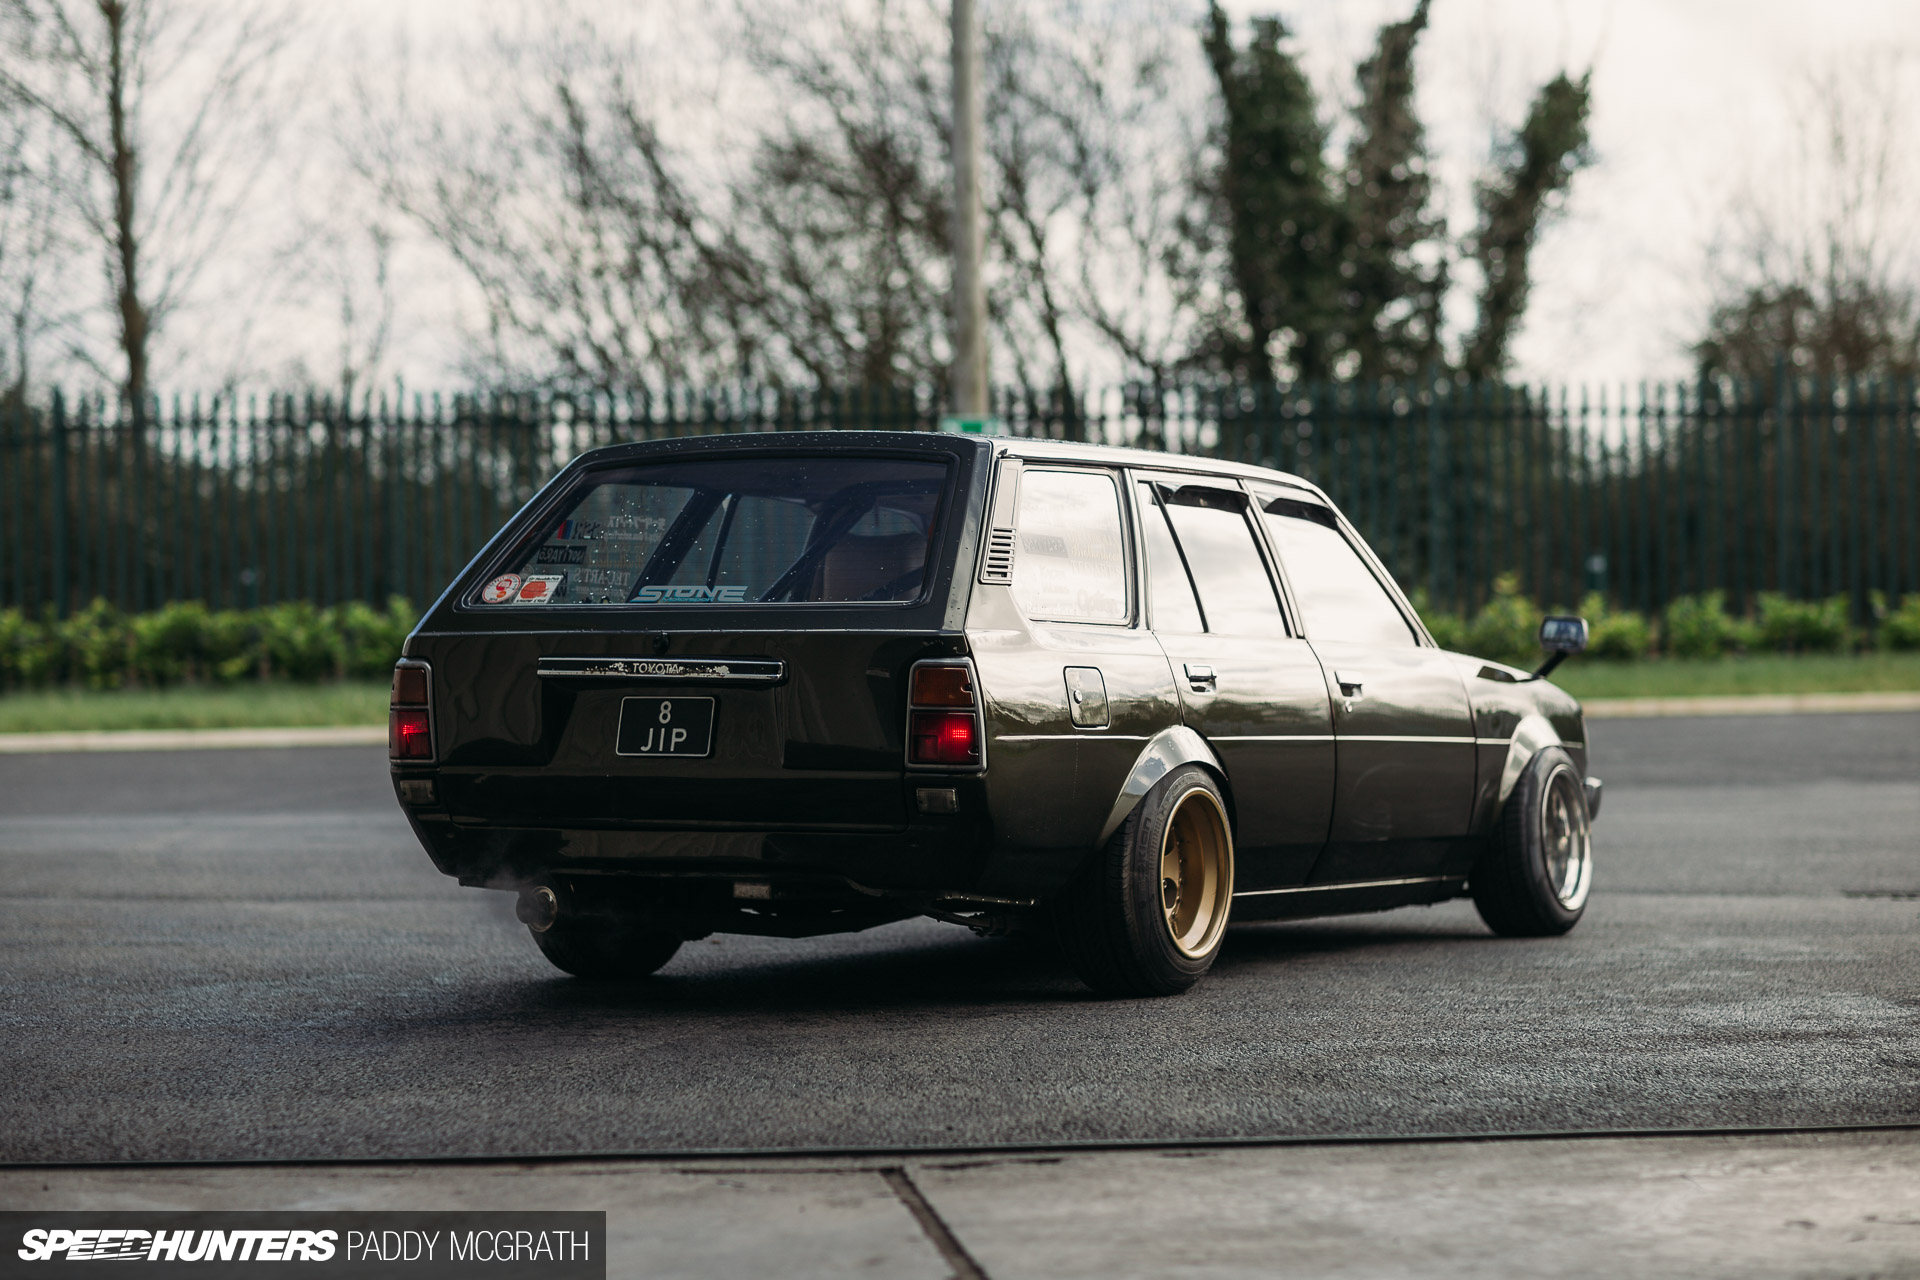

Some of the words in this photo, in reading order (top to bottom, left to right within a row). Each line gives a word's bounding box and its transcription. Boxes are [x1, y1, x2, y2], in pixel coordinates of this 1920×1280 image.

[630, 585, 748, 602] STONE
[632, 662, 681, 674] TOYOTA
[659, 701, 672, 724] 8
[640, 728, 687, 752] JIP
